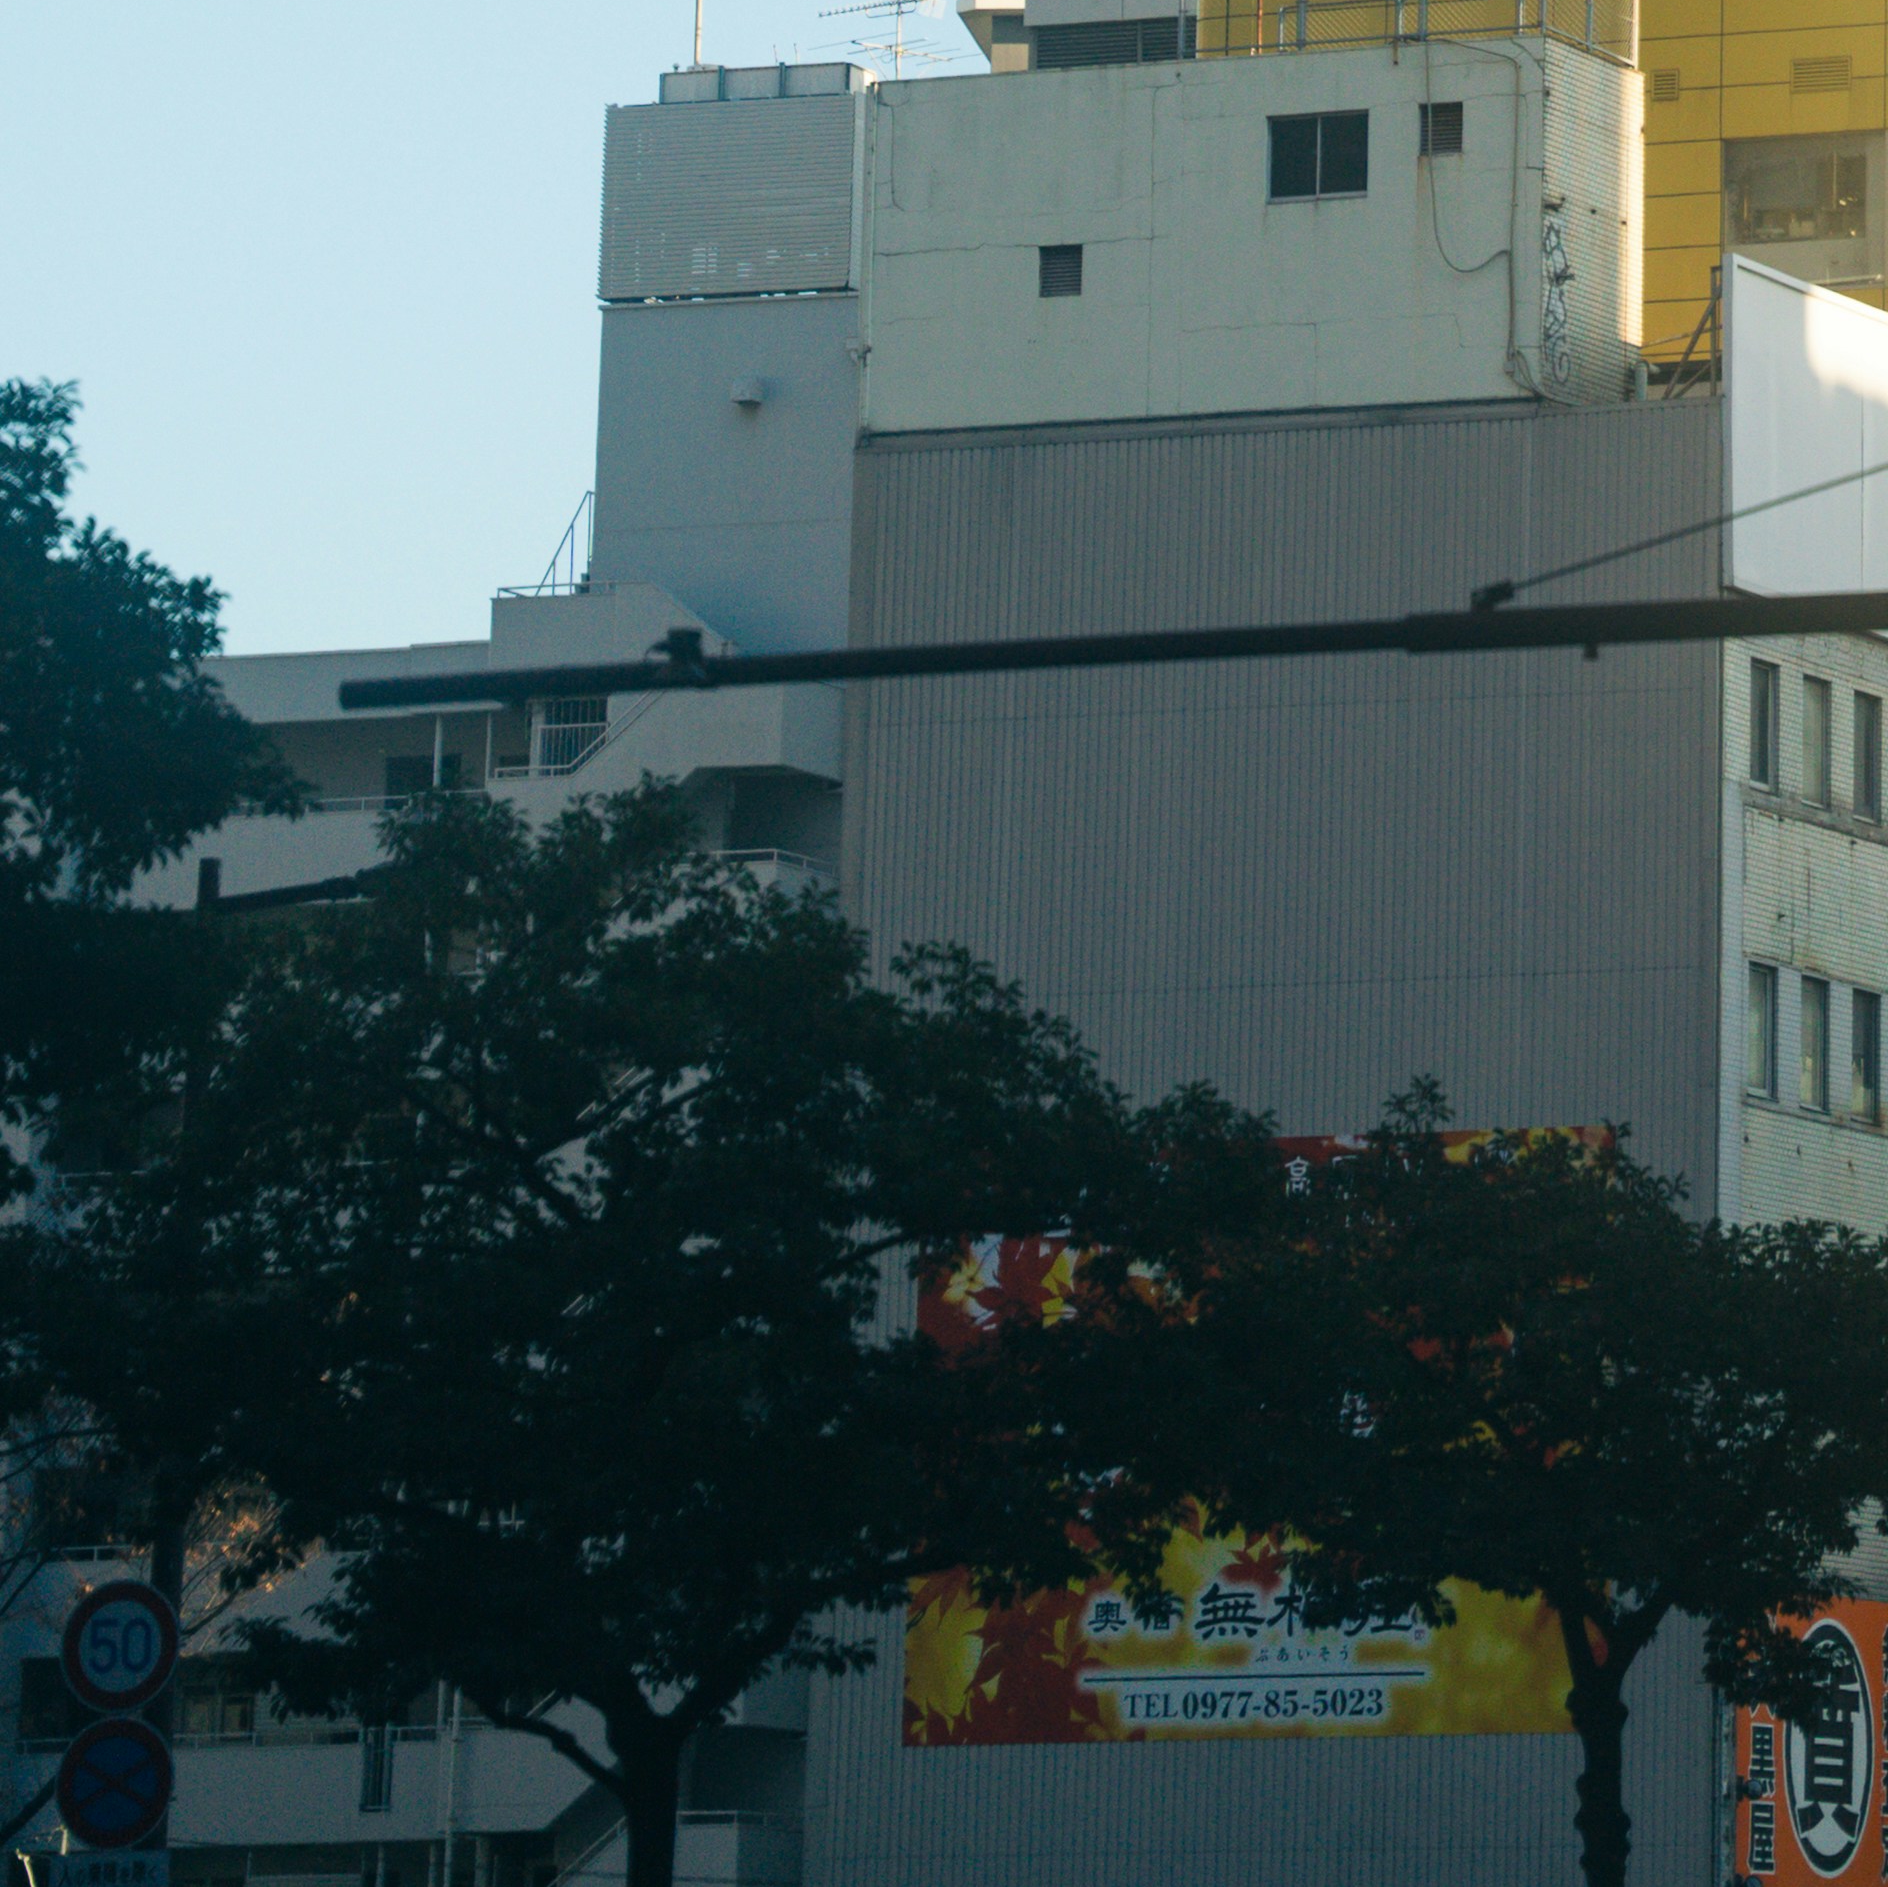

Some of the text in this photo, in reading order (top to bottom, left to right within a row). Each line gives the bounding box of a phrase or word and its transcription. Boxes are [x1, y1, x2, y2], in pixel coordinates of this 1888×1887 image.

[87, 1617, 152, 1674] 50
[1181, 1688, 1384, 1720] 0977-85-5023
[1747, 1703, 1777, 1875] 黒屋
